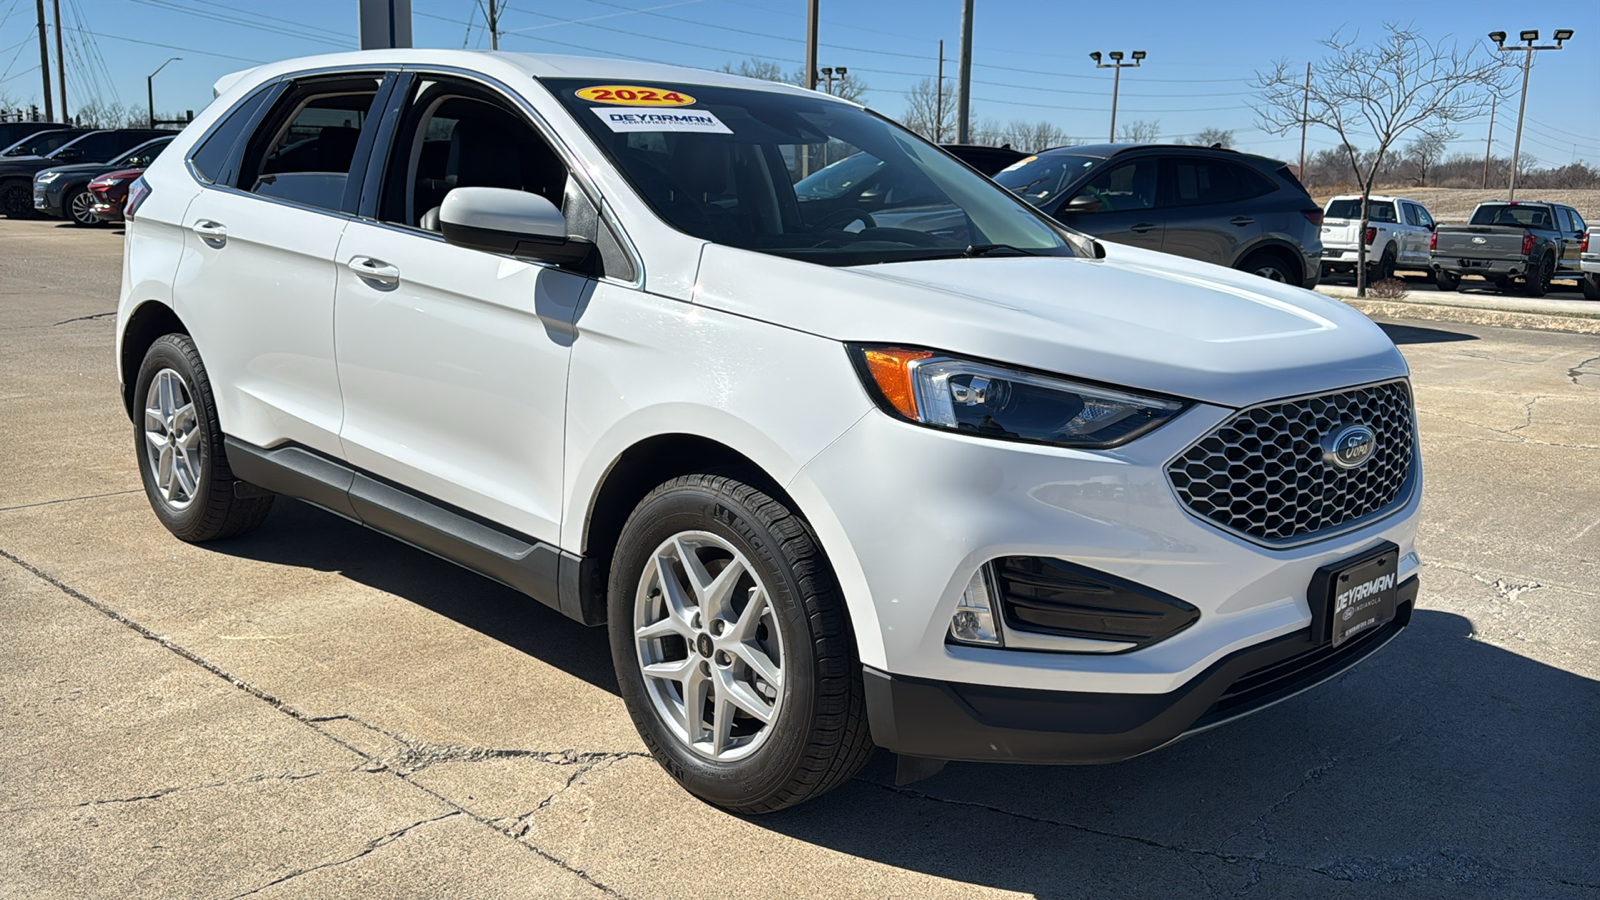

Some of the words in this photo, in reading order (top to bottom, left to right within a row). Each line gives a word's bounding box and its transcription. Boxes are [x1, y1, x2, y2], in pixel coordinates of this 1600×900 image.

[590, 89, 686, 103] 2024
[609, 113, 714, 123] DEYARMAN
[1345, 435, 1369, 459] Ford
[731, 516, 797, 613] MICHELIN
[1335, 572, 1396, 614] DEYARMAN
[1355, 596, 1382, 613] INDIANOLA
